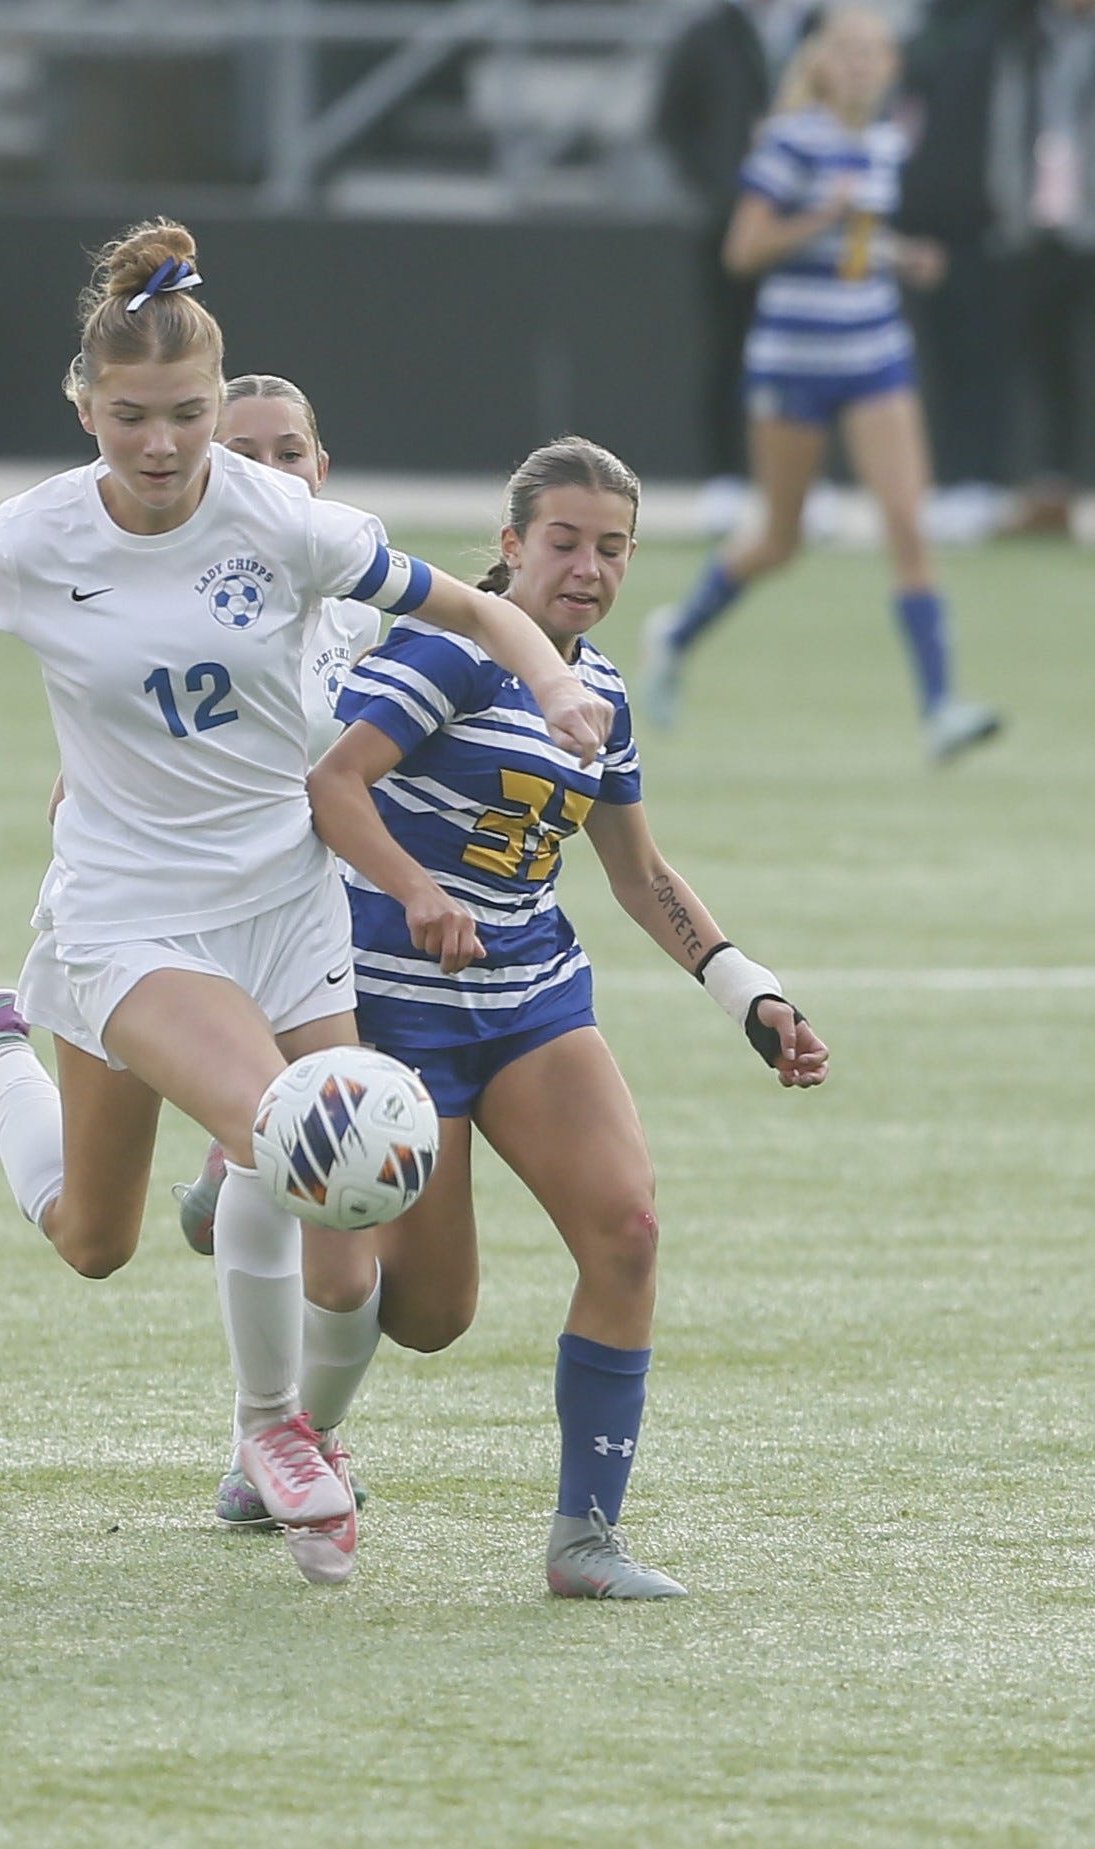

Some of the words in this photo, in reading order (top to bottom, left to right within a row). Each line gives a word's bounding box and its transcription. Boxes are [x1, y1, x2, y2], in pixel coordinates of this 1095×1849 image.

[193, 562, 223, 595] LADY
[226, 558, 275, 583] CHIPPS
[312, 649, 333, 676] LADY
[143, 661, 239, 738] 12
[651, 875, 703, 960] COMPETE
